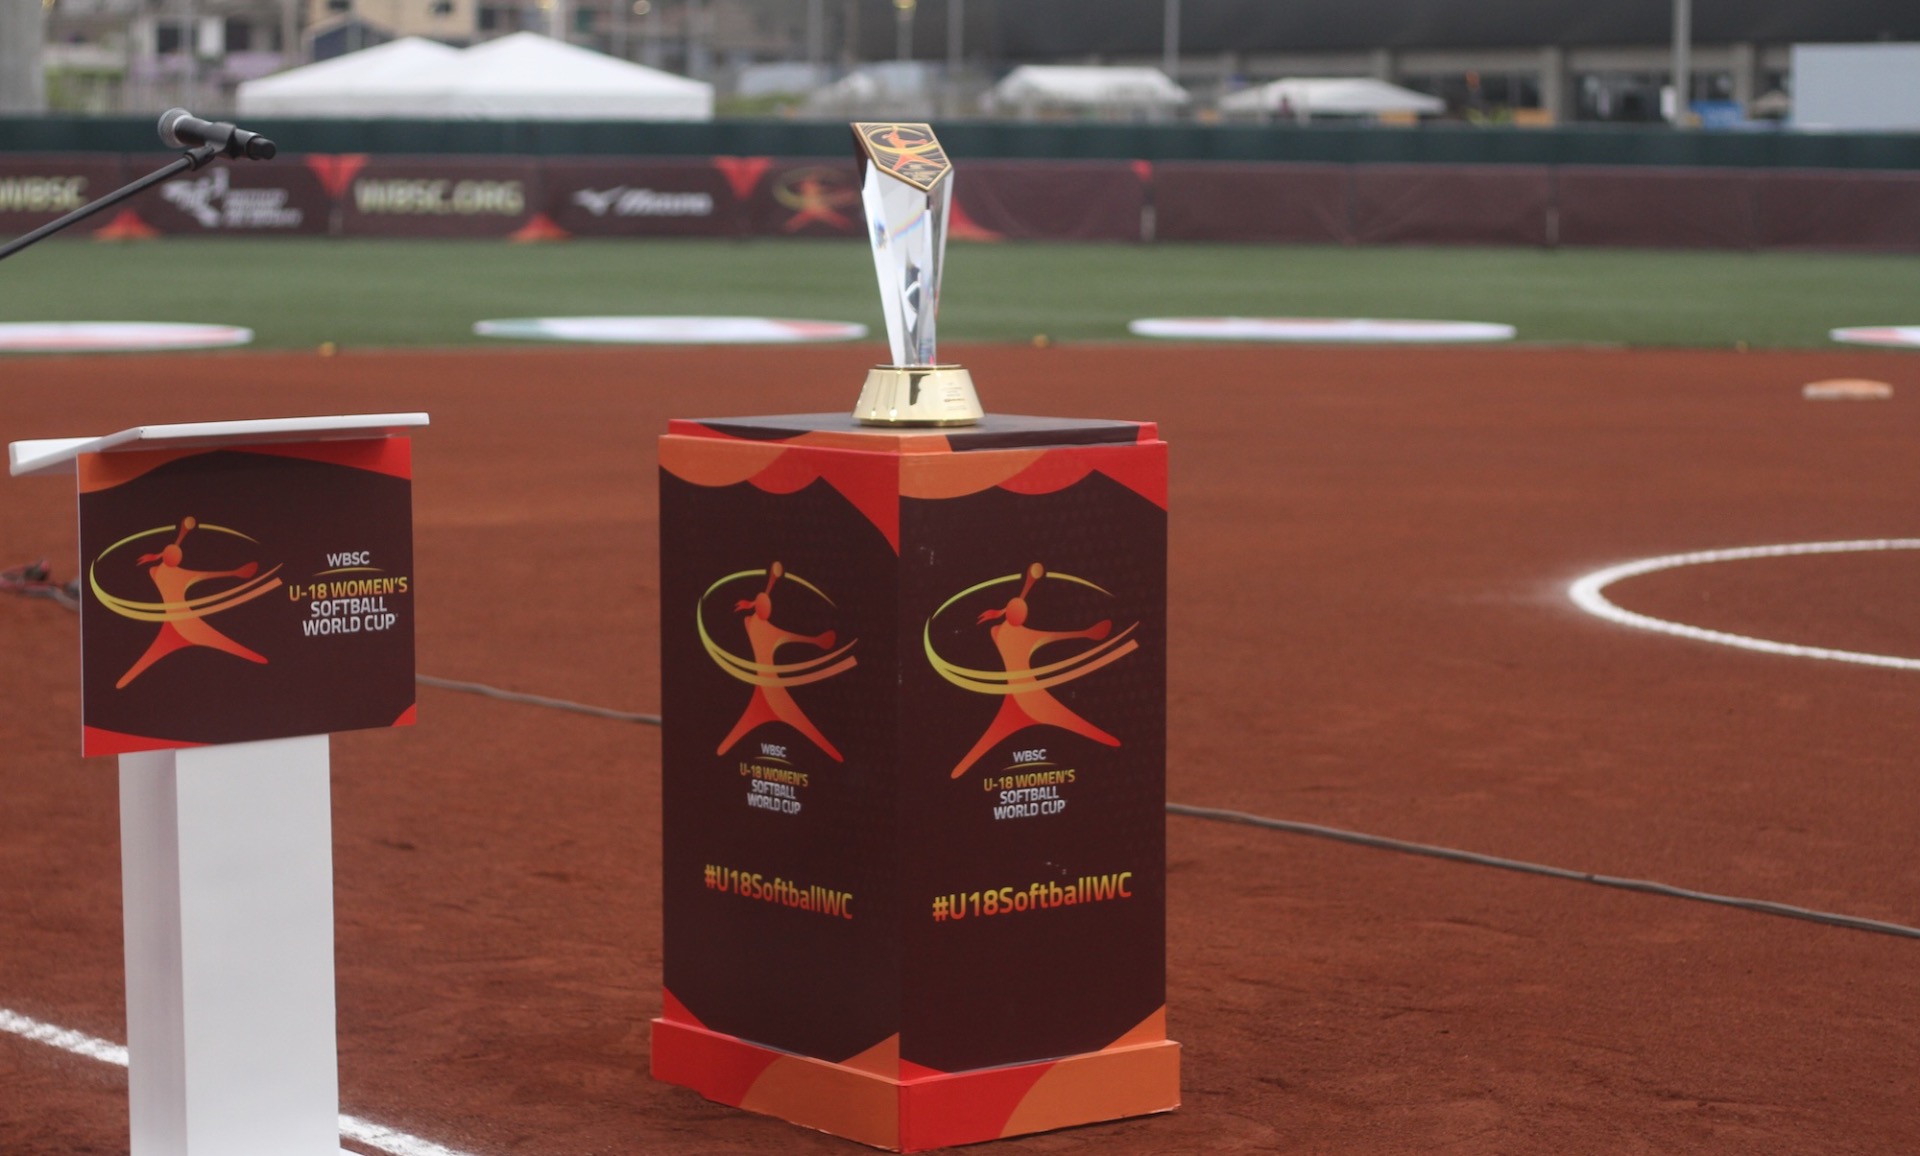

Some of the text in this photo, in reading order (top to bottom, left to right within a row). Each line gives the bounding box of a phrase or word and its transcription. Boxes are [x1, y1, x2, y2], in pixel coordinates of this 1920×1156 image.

[354, 177, 525, 216] WBSC.ORG
[326, 551, 370, 567] WBSC
[289, 576, 408, 601] U-18 WOMEN'S
[310, 596, 387, 618] SOFTBALL
[302, 613, 396, 636] WORLD CUP
[760, 742, 787, 758] WBSC
[1012, 749, 1047, 763] WBSC
[739, 762, 809, 787] U-18 WOMEN'S
[984, 769, 1076, 791] U-18 WOMEN'S
[751, 779, 796, 799] SOFTBALL
[1000, 786, 1059, 804] SOFTBALL
[747, 792, 801, 814] WORLD CUP
[993, 799, 1066, 820] WORLD CUP
[704, 864, 853, 919] #U18SoftballWC
[932, 872, 1132, 921] #U18SoftballWC
